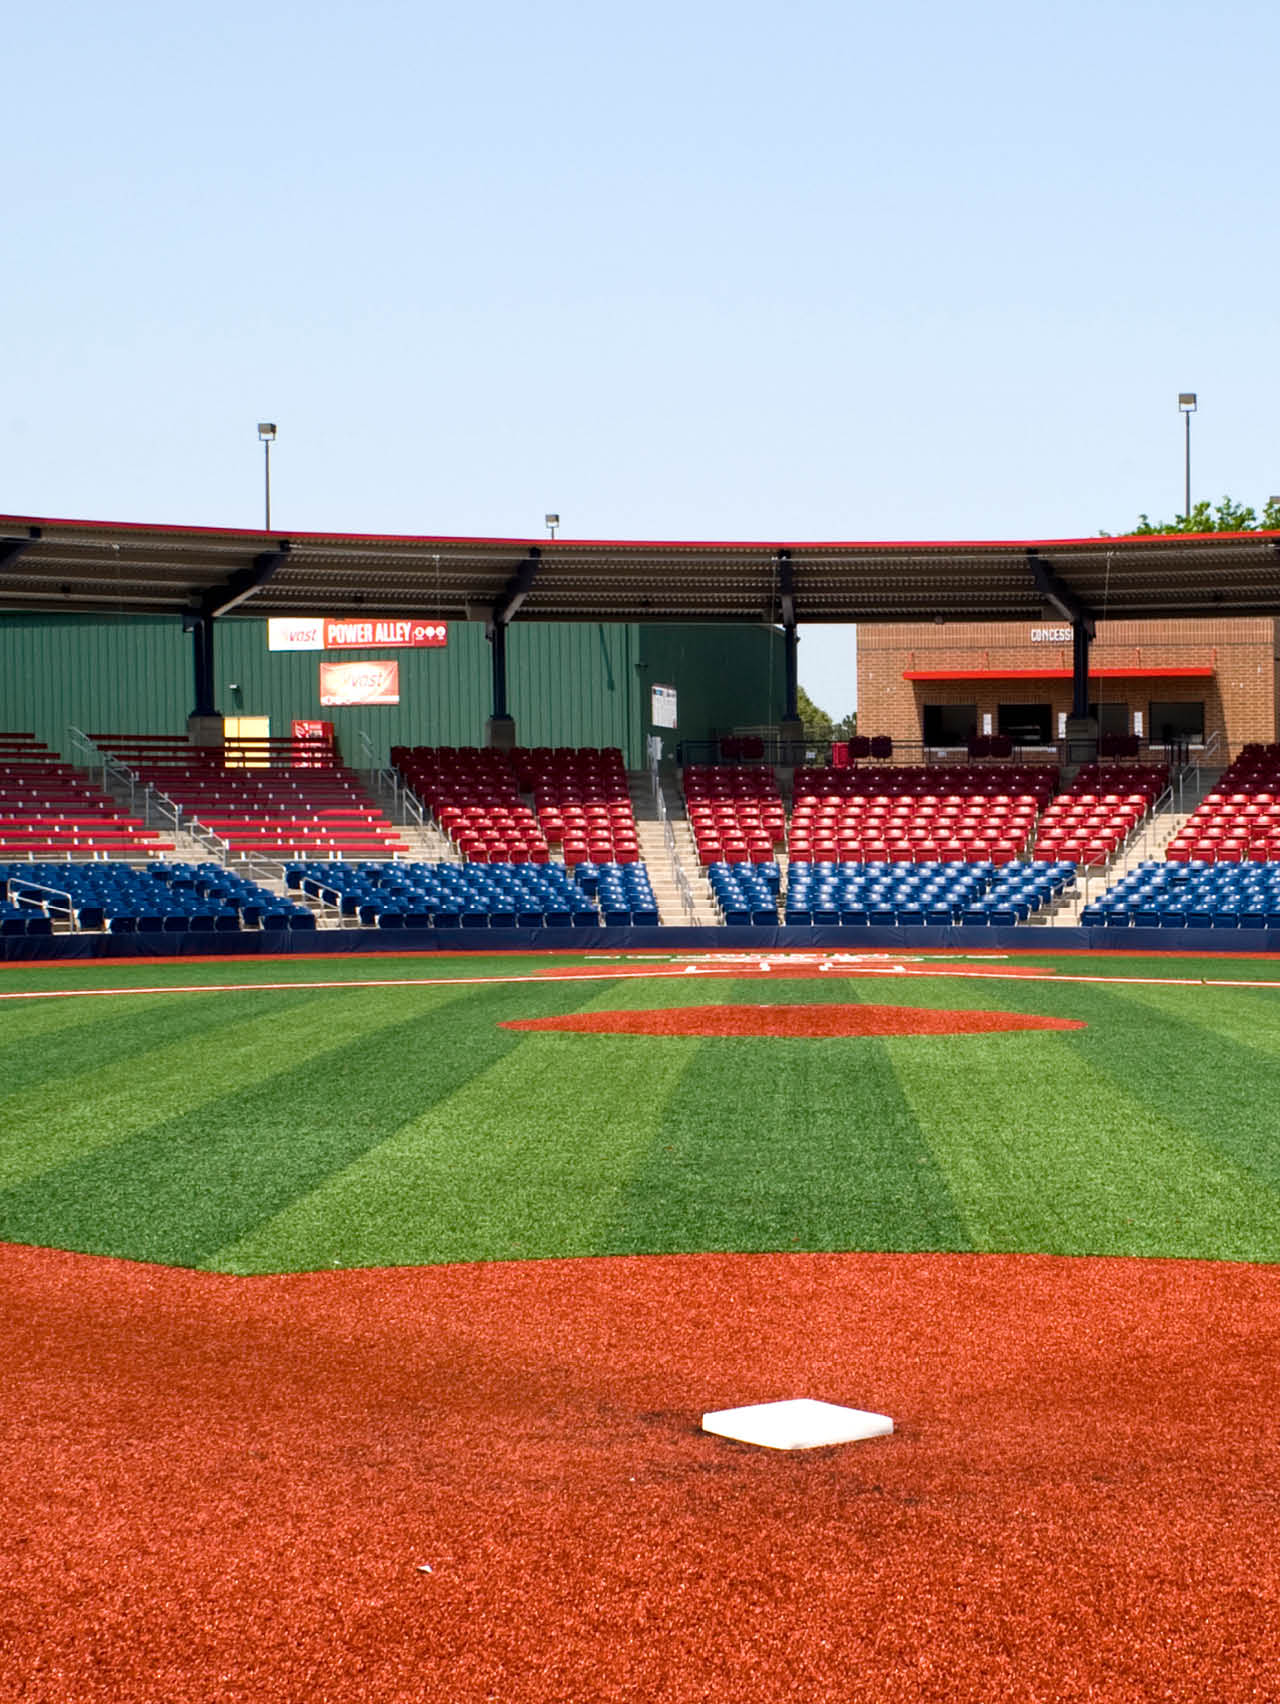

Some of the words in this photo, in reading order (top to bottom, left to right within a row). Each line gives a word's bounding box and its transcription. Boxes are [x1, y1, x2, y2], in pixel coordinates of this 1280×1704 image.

[328, 623, 373, 643] POWER
[375, 622, 412, 642] ALLEY
[1031, 629, 1074, 641] CONCESSI
